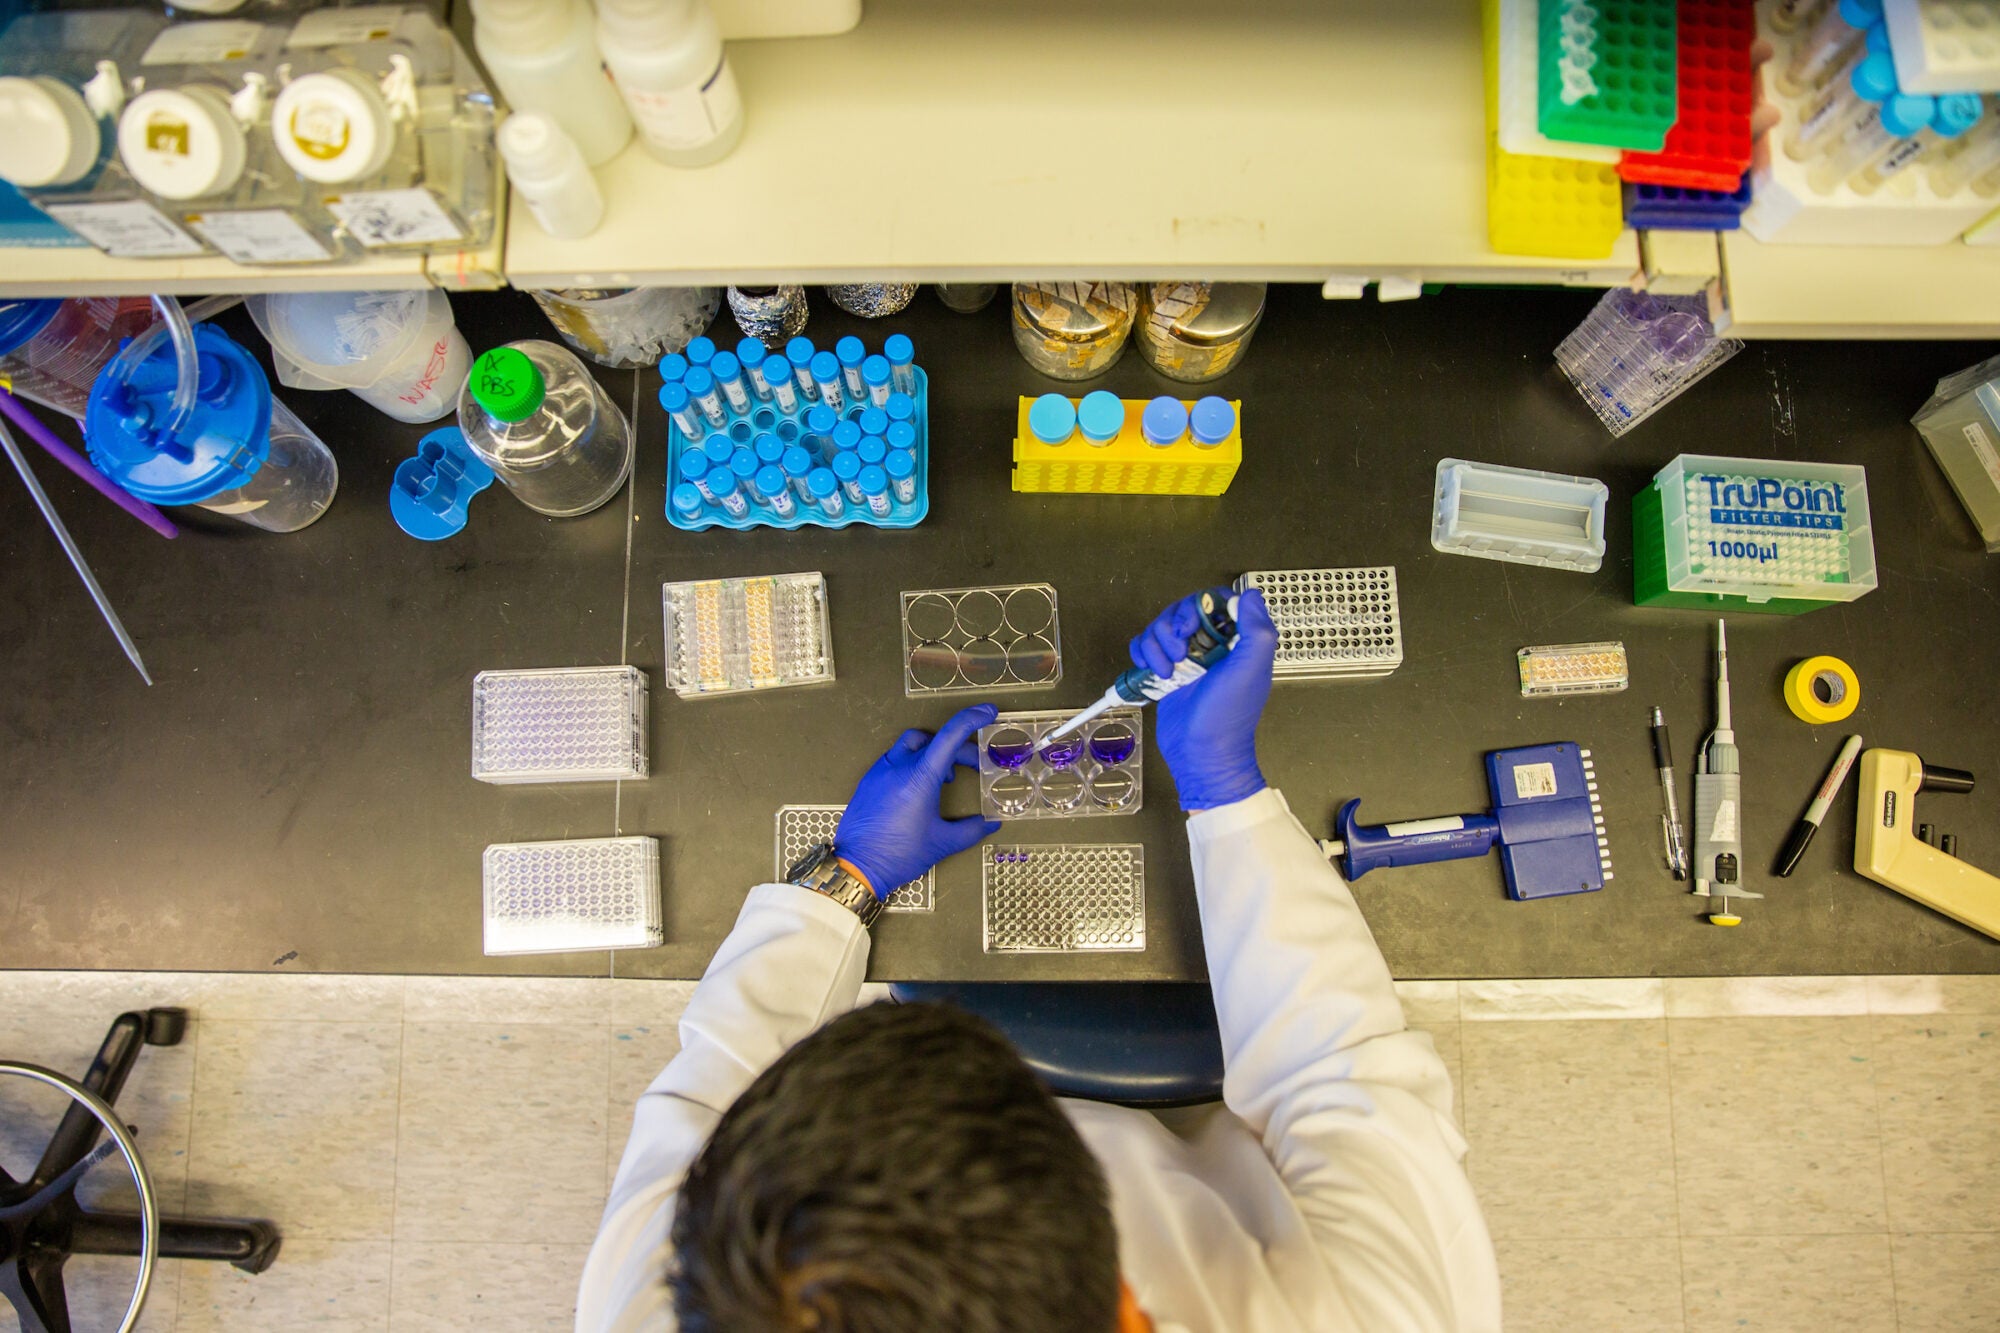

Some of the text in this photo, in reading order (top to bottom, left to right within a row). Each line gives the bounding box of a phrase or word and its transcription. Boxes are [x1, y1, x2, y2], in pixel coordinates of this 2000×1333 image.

[481, 375, 515, 397] PBS
[1701, 476, 1847, 513] TruPoint
[1720, 512, 1834, 527] FILTER TIPS
